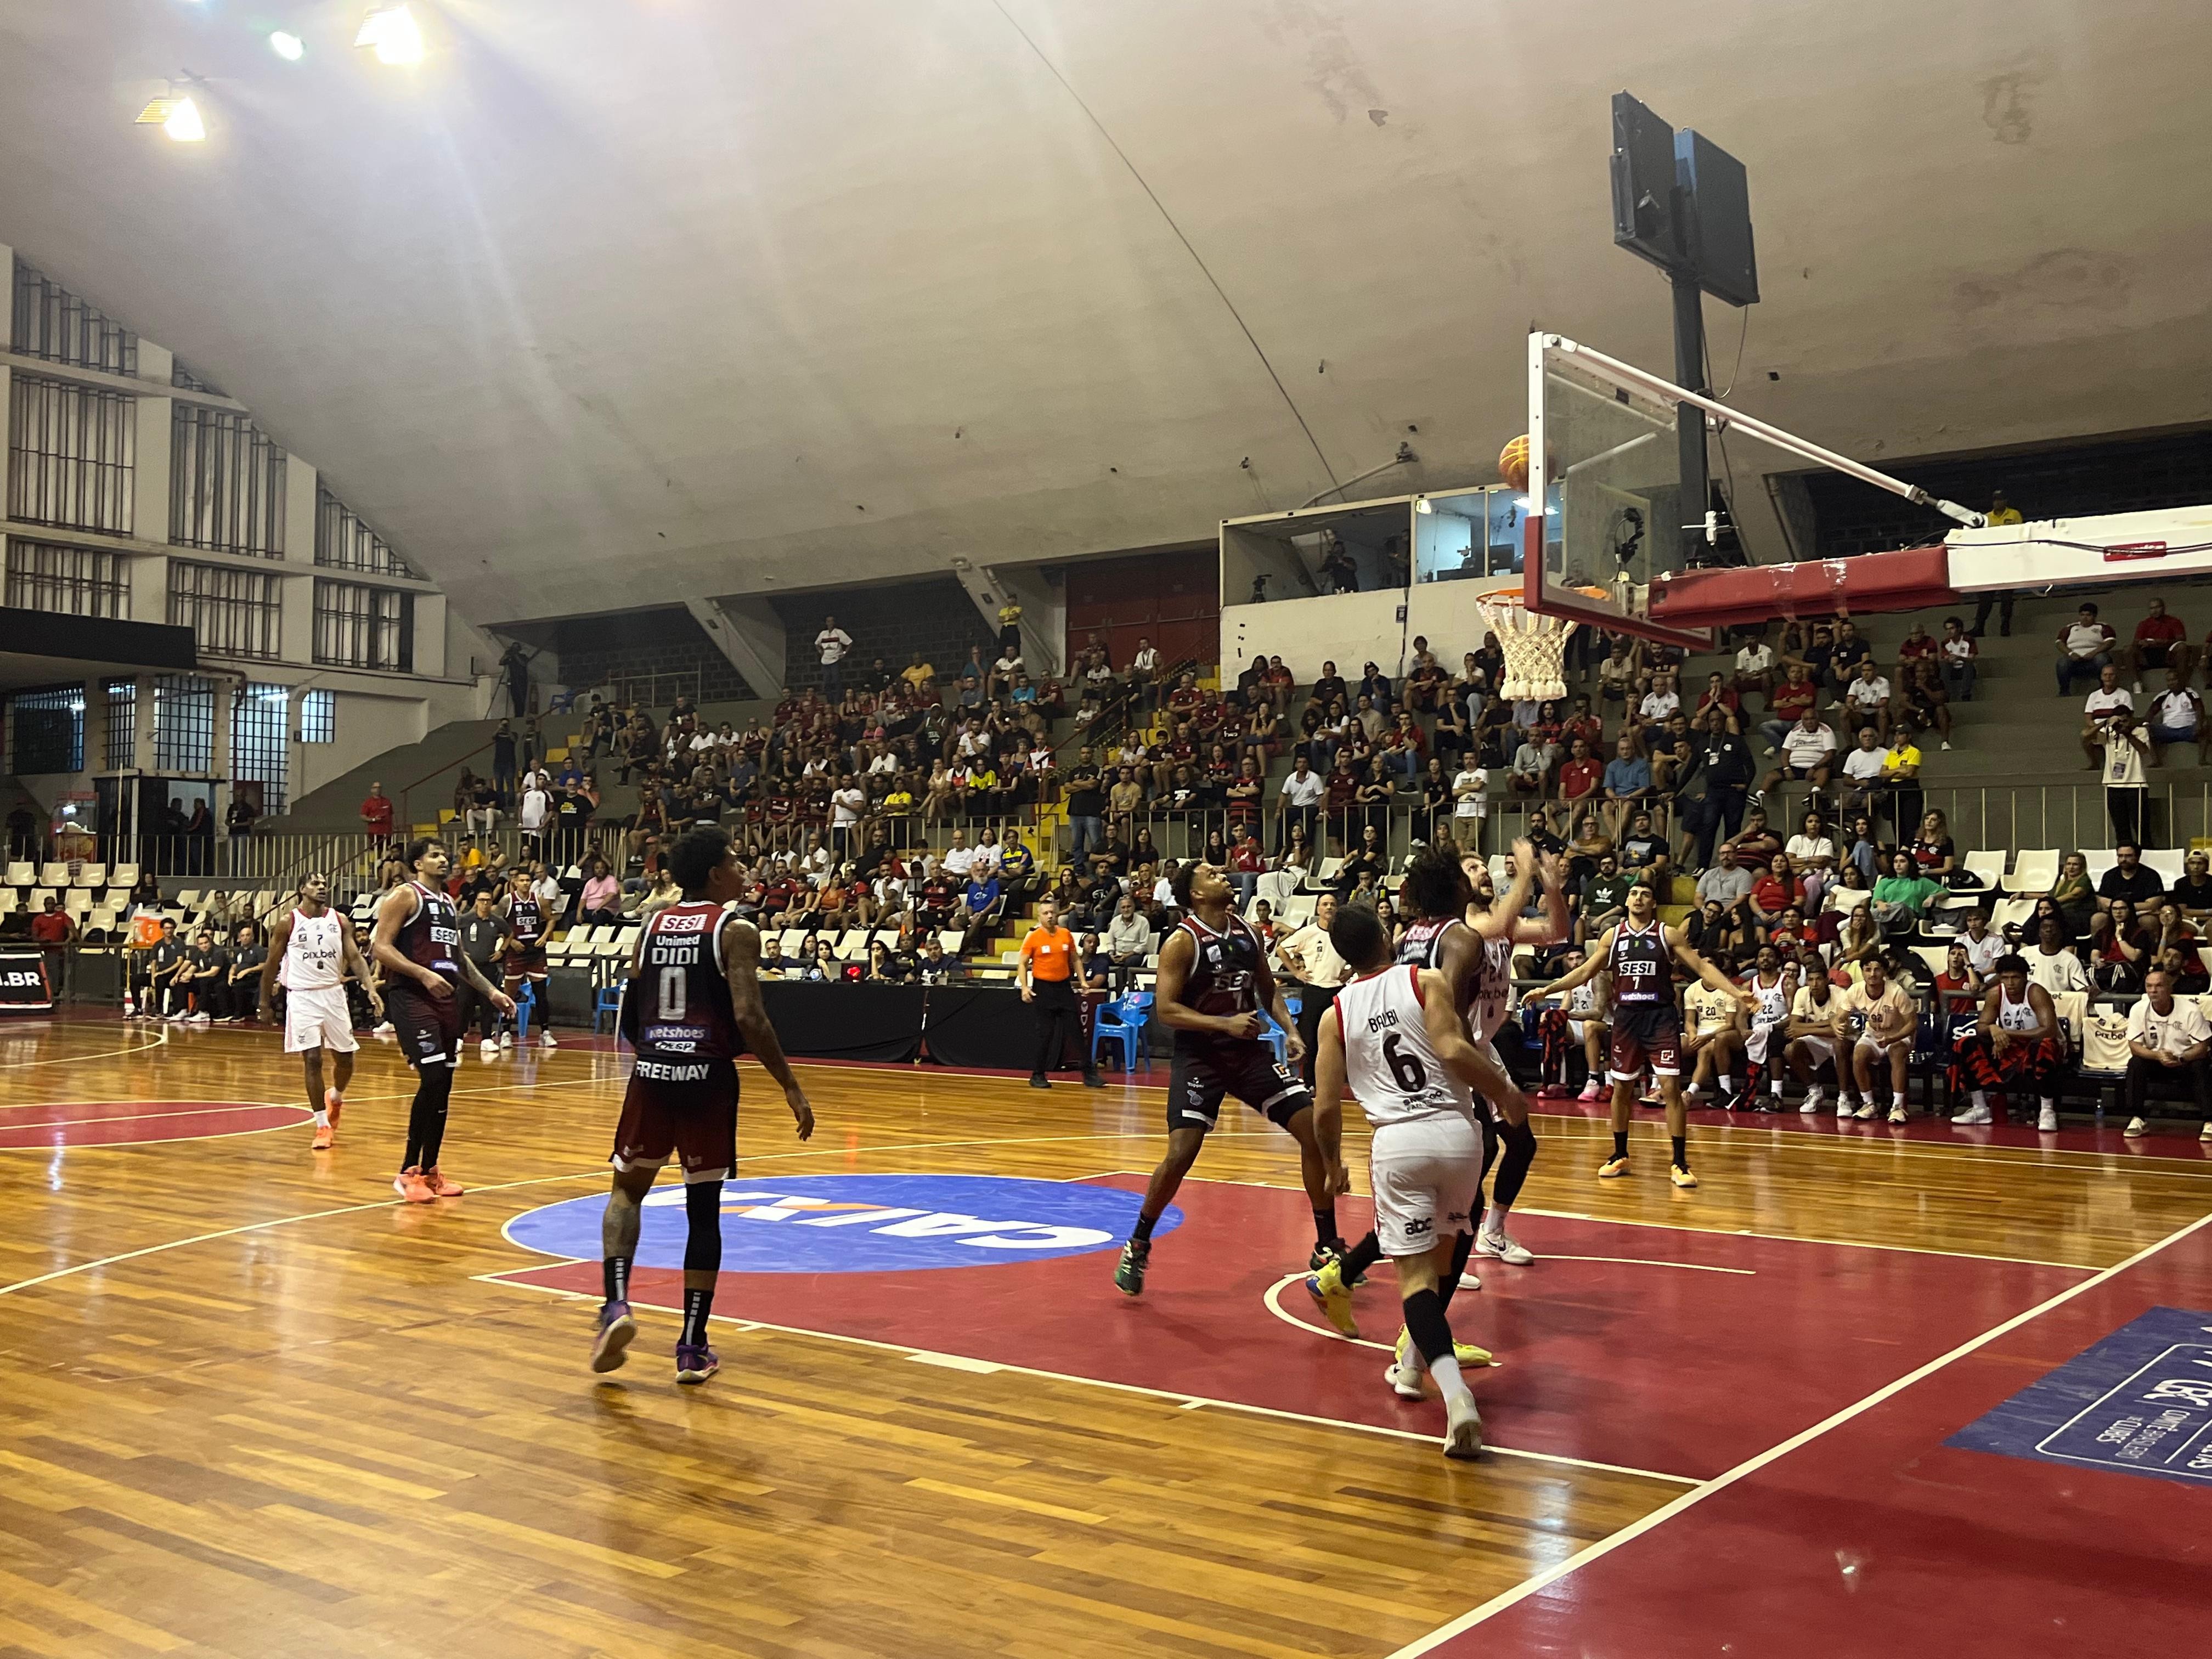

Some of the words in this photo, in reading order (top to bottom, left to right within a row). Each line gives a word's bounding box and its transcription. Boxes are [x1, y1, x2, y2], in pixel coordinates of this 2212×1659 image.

[664, 917, 702, 929] SESI
[656, 934, 701, 946] Unimed
[651, 947, 699, 964] DIDI
[1621, 962, 1652, 974] SESI
[0, 972, 42, 986] .BR
[1632, 976, 1640, 990] 7
[659, 966, 686, 1020] 0
[1706, 1007, 1716, 1016] 20
[1762, 1004, 1774, 1014] 22
[1368, 1009, 1400, 1033] BALBI
[649, 1026, 706, 1039] netshoes
[1383, 1033, 1426, 1093] 6
[635, 1060, 711, 1081] FREEWAY
